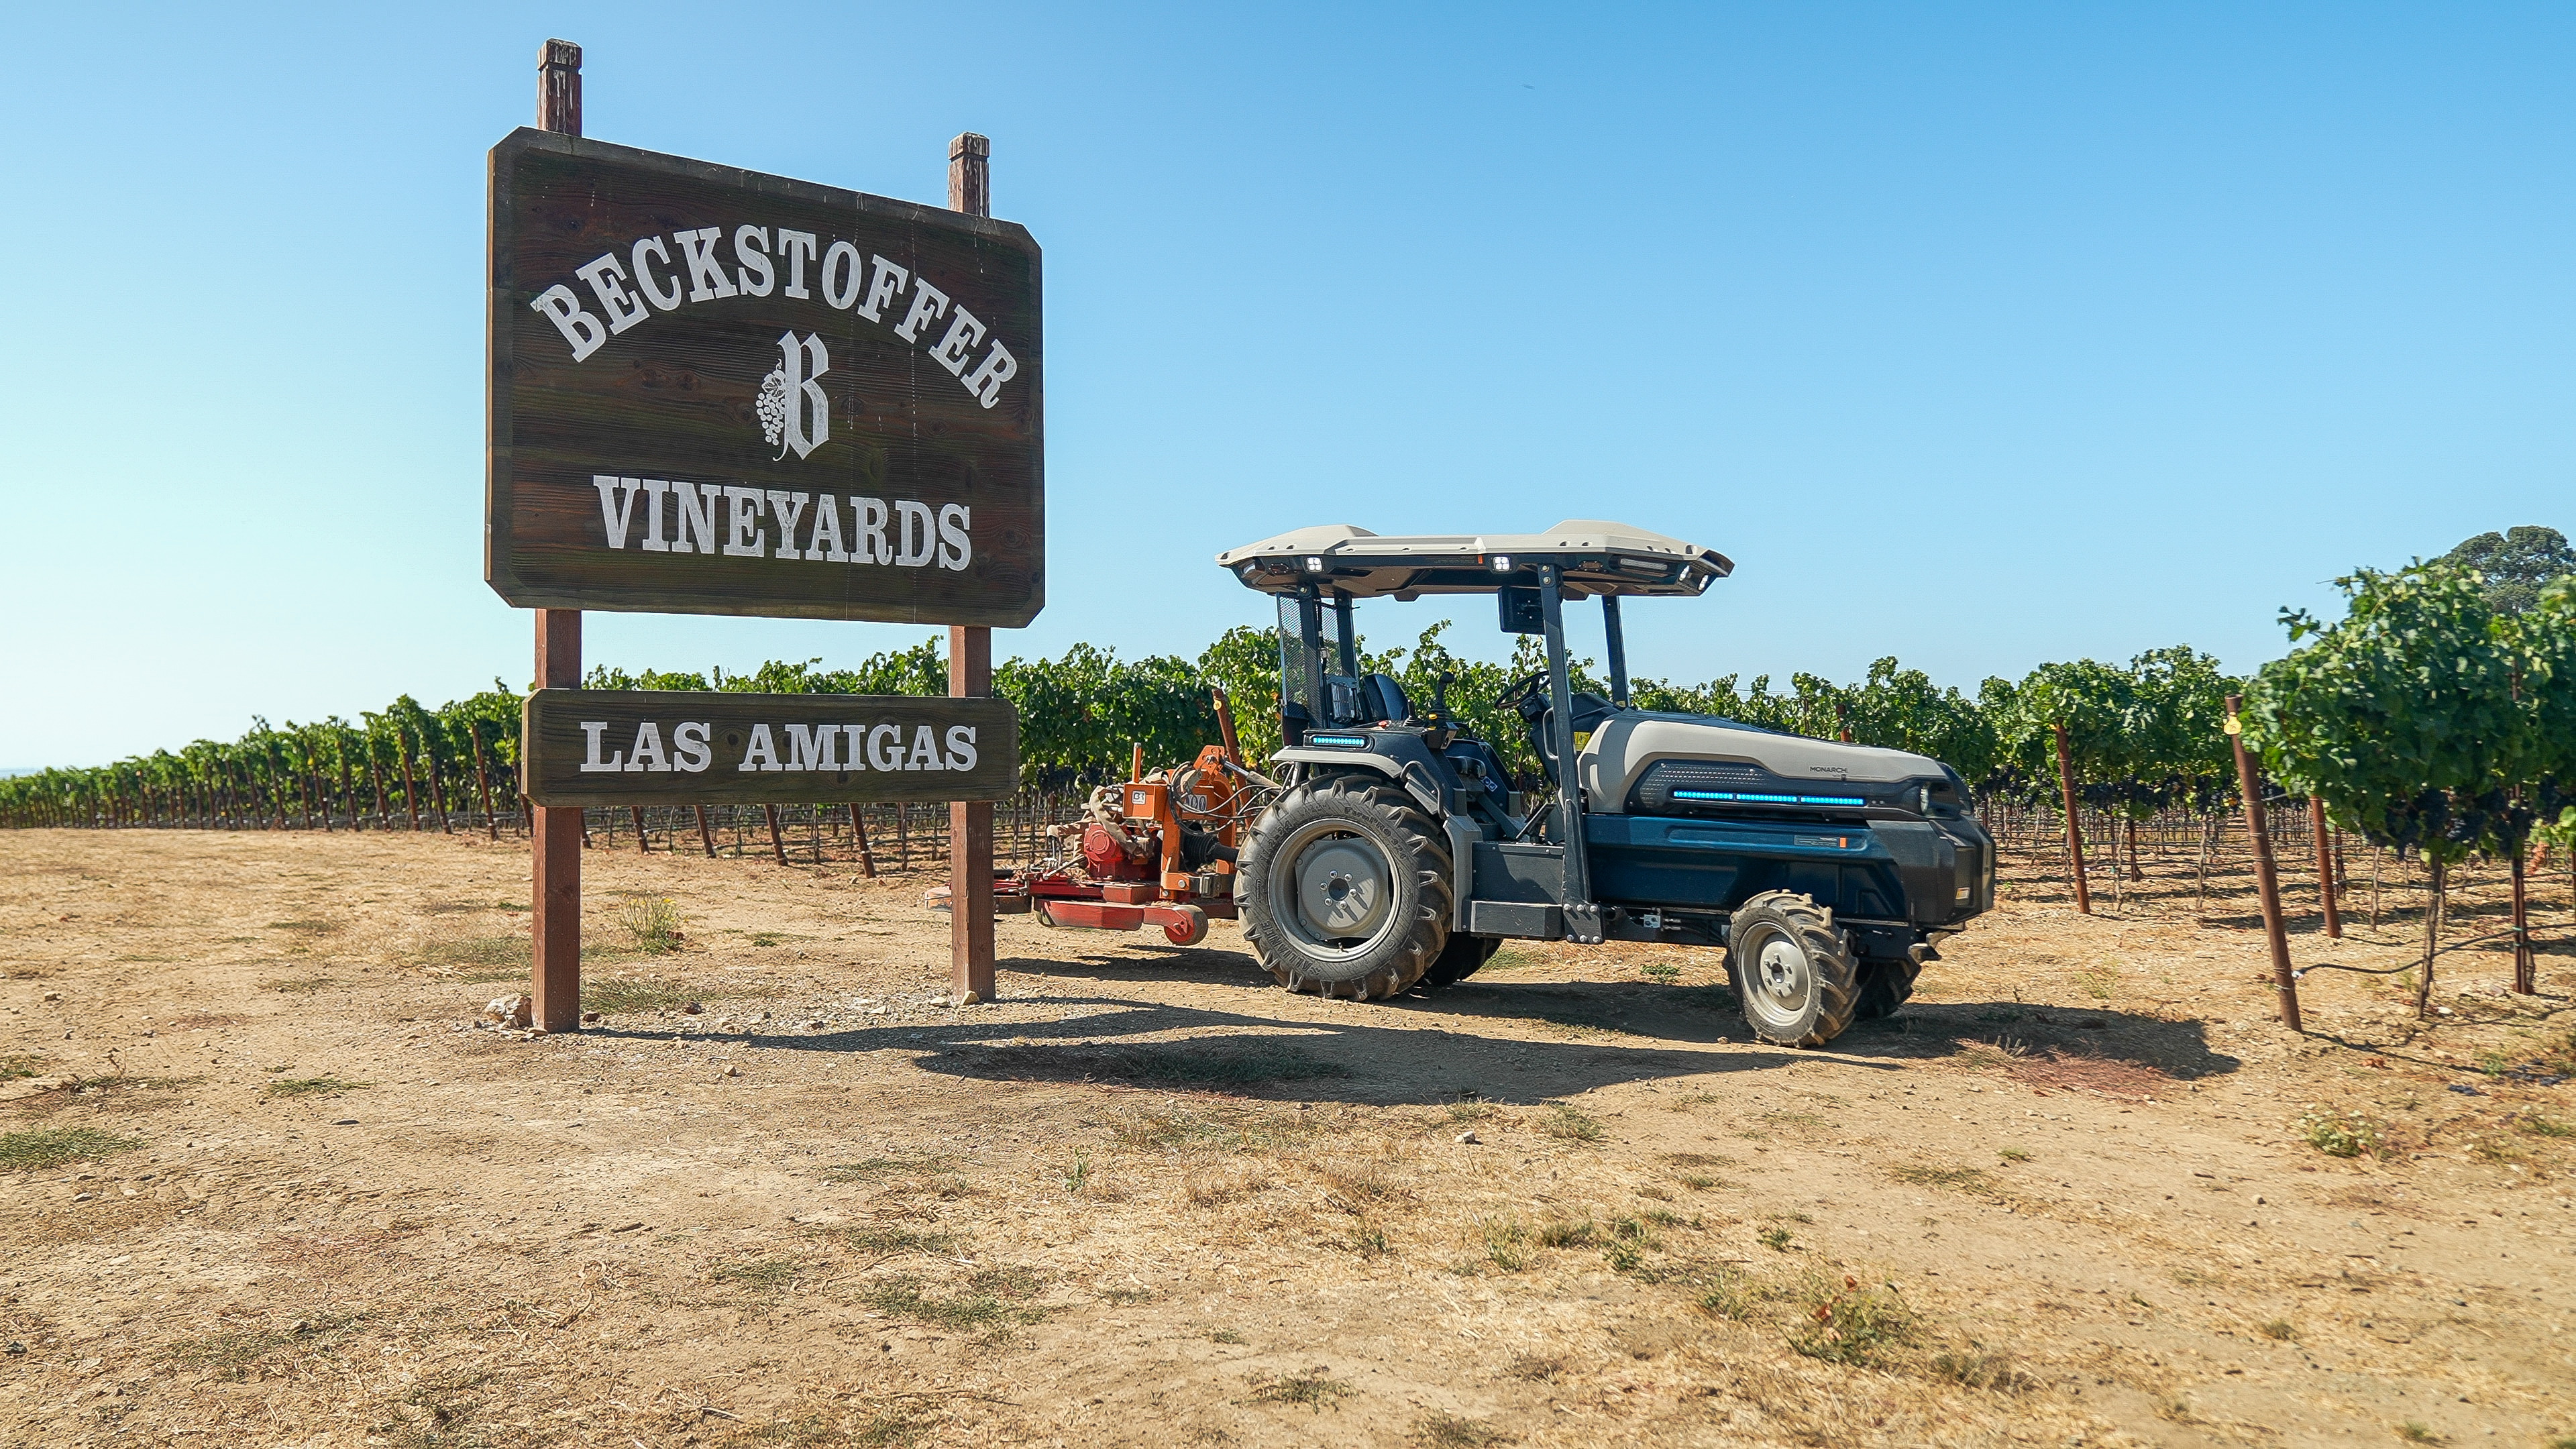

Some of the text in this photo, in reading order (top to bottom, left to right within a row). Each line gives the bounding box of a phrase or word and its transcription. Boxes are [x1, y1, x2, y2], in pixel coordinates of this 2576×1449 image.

[530, 225, 1018, 410] BECKSTOFFER
[593, 475, 971, 572] VINEYARDS
[580, 721, 977, 772] LAS AMIGAS
[1262, 920, 1313, 971] ALLIANCE
